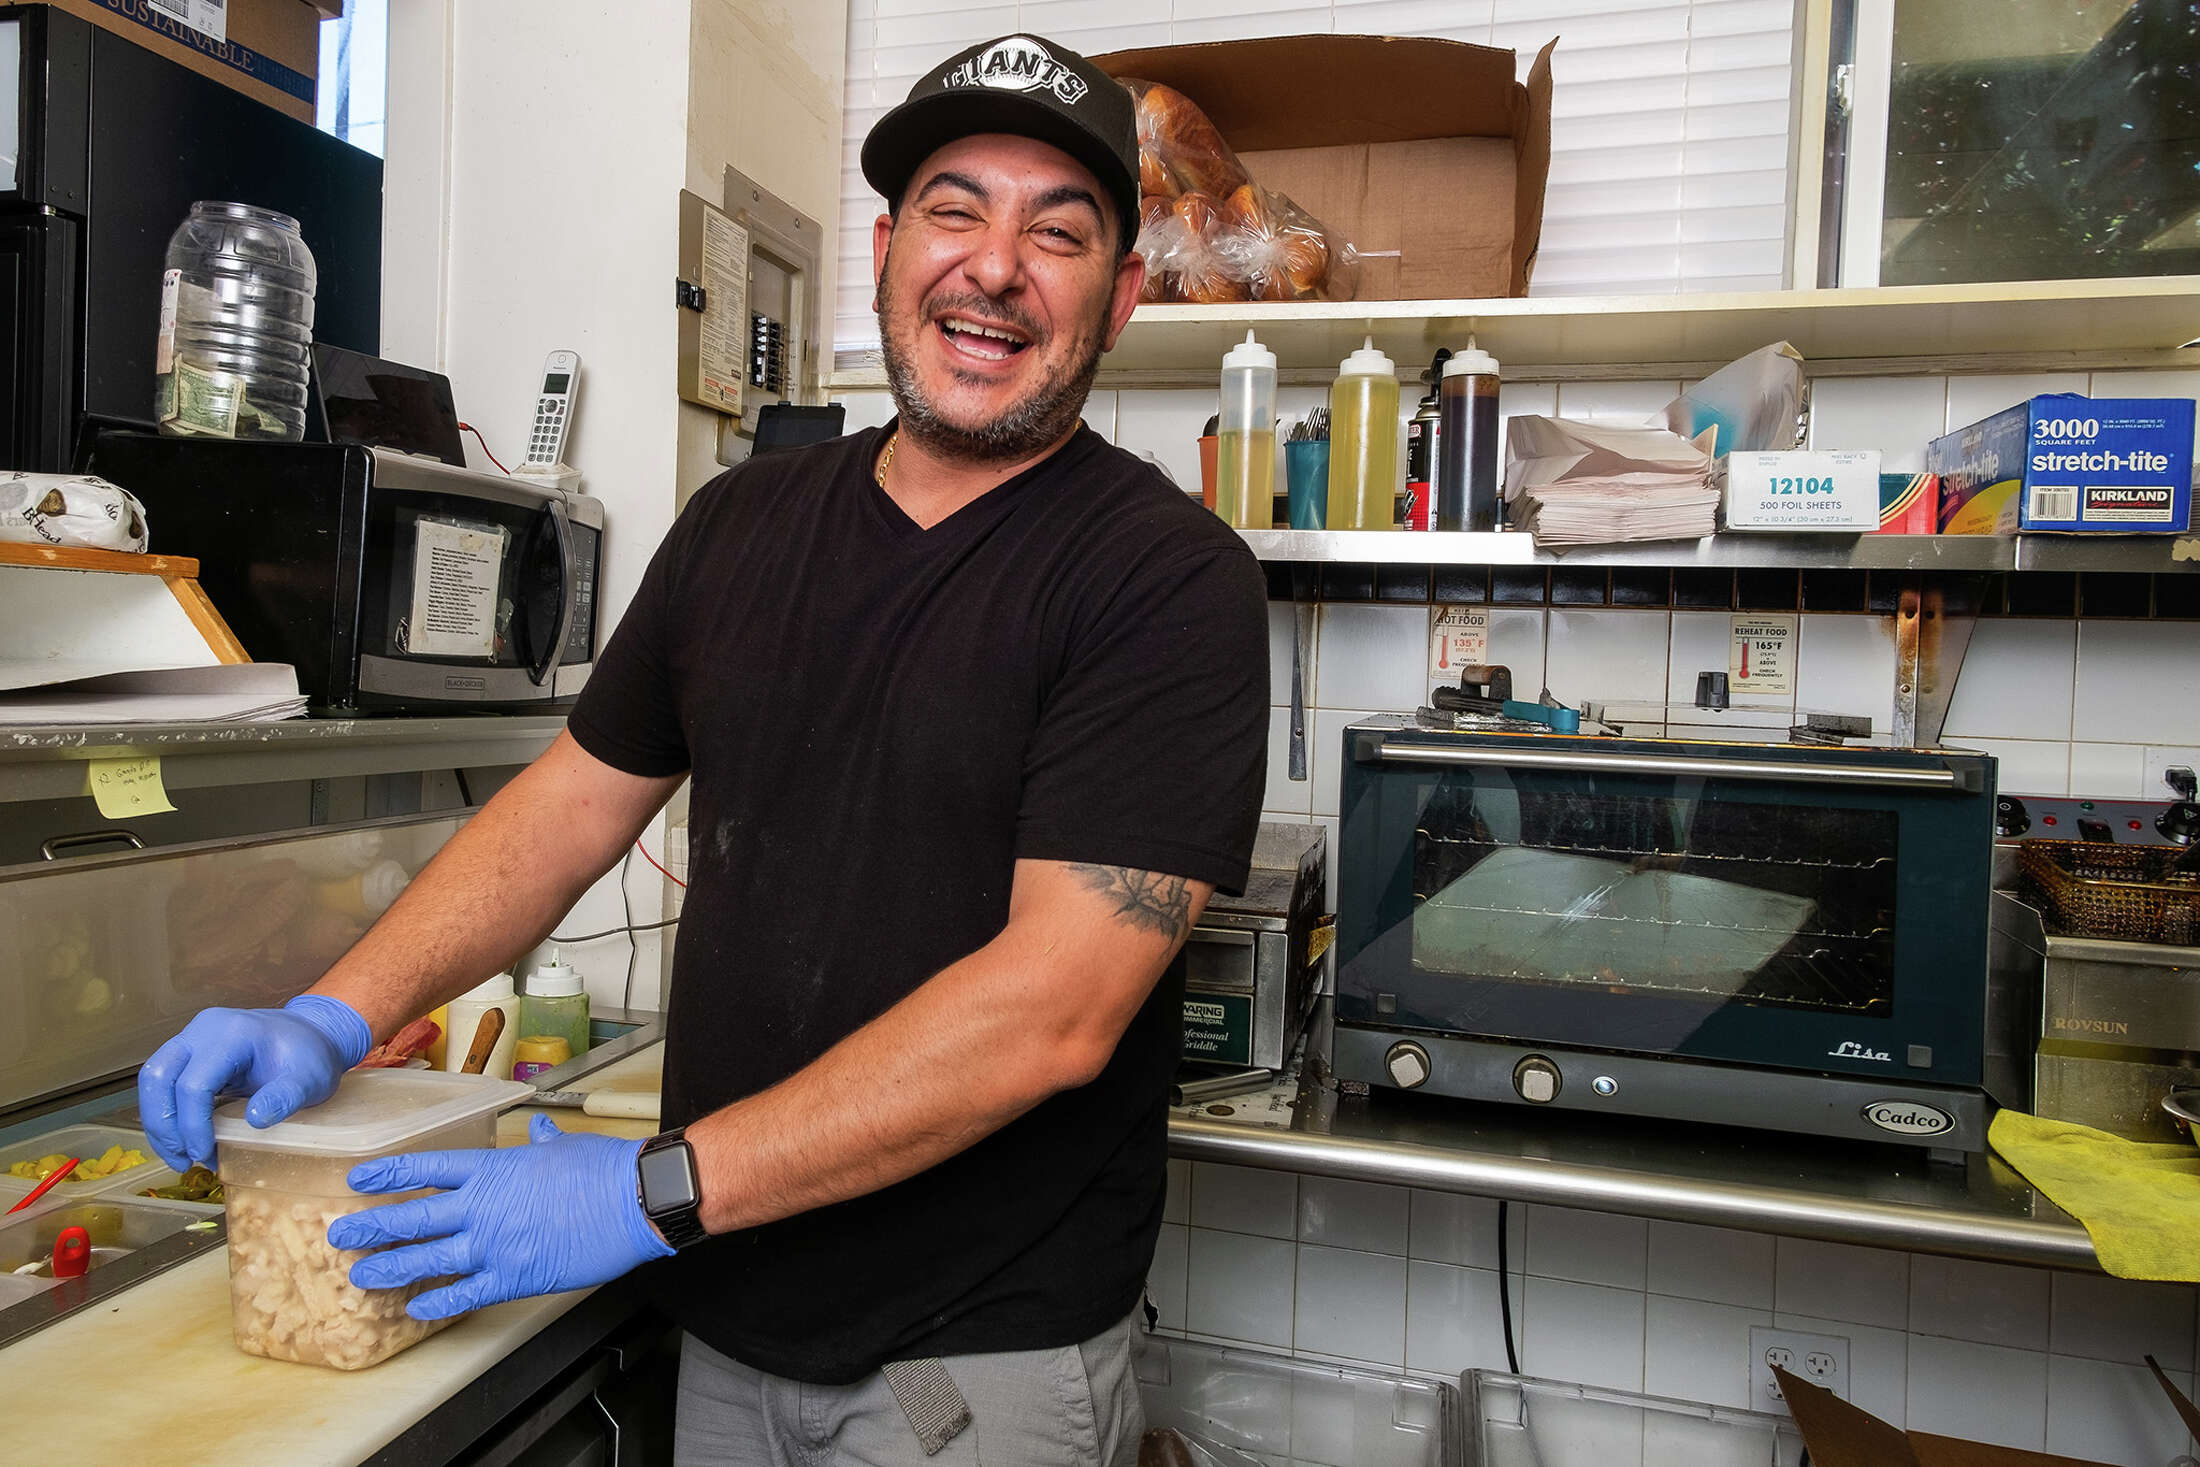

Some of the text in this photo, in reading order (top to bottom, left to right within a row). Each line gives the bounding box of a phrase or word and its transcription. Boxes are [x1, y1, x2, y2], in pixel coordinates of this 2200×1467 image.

[942, 49, 1089, 105] GIANTS
[2033, 418, 2100, 439] 3000
[2032, 450, 2169, 472] stretch-tite
[1942, 449, 1999, 497] stretch-tite
[1769, 477, 1834, 495] 12104
[2091, 490, 2168, 502] KIRKLAND
[1760, 501, 1842, 510] 500 FOIL SHEETS
[1458, 616, 1485, 625] FOOD
[1735, 627, 1788, 636] REHEAT FOOD
[1756, 641, 1783, 650] 165°F
[1183, 1016, 1225, 1026] MMERCIAL
[2055, 1018, 2129, 1034] ROVSUN
[1183, 1028, 1229, 1042] ofessional
[1828, 1041, 1892, 1062] Lisa
[1875, 1108, 1941, 1128] Cadco
